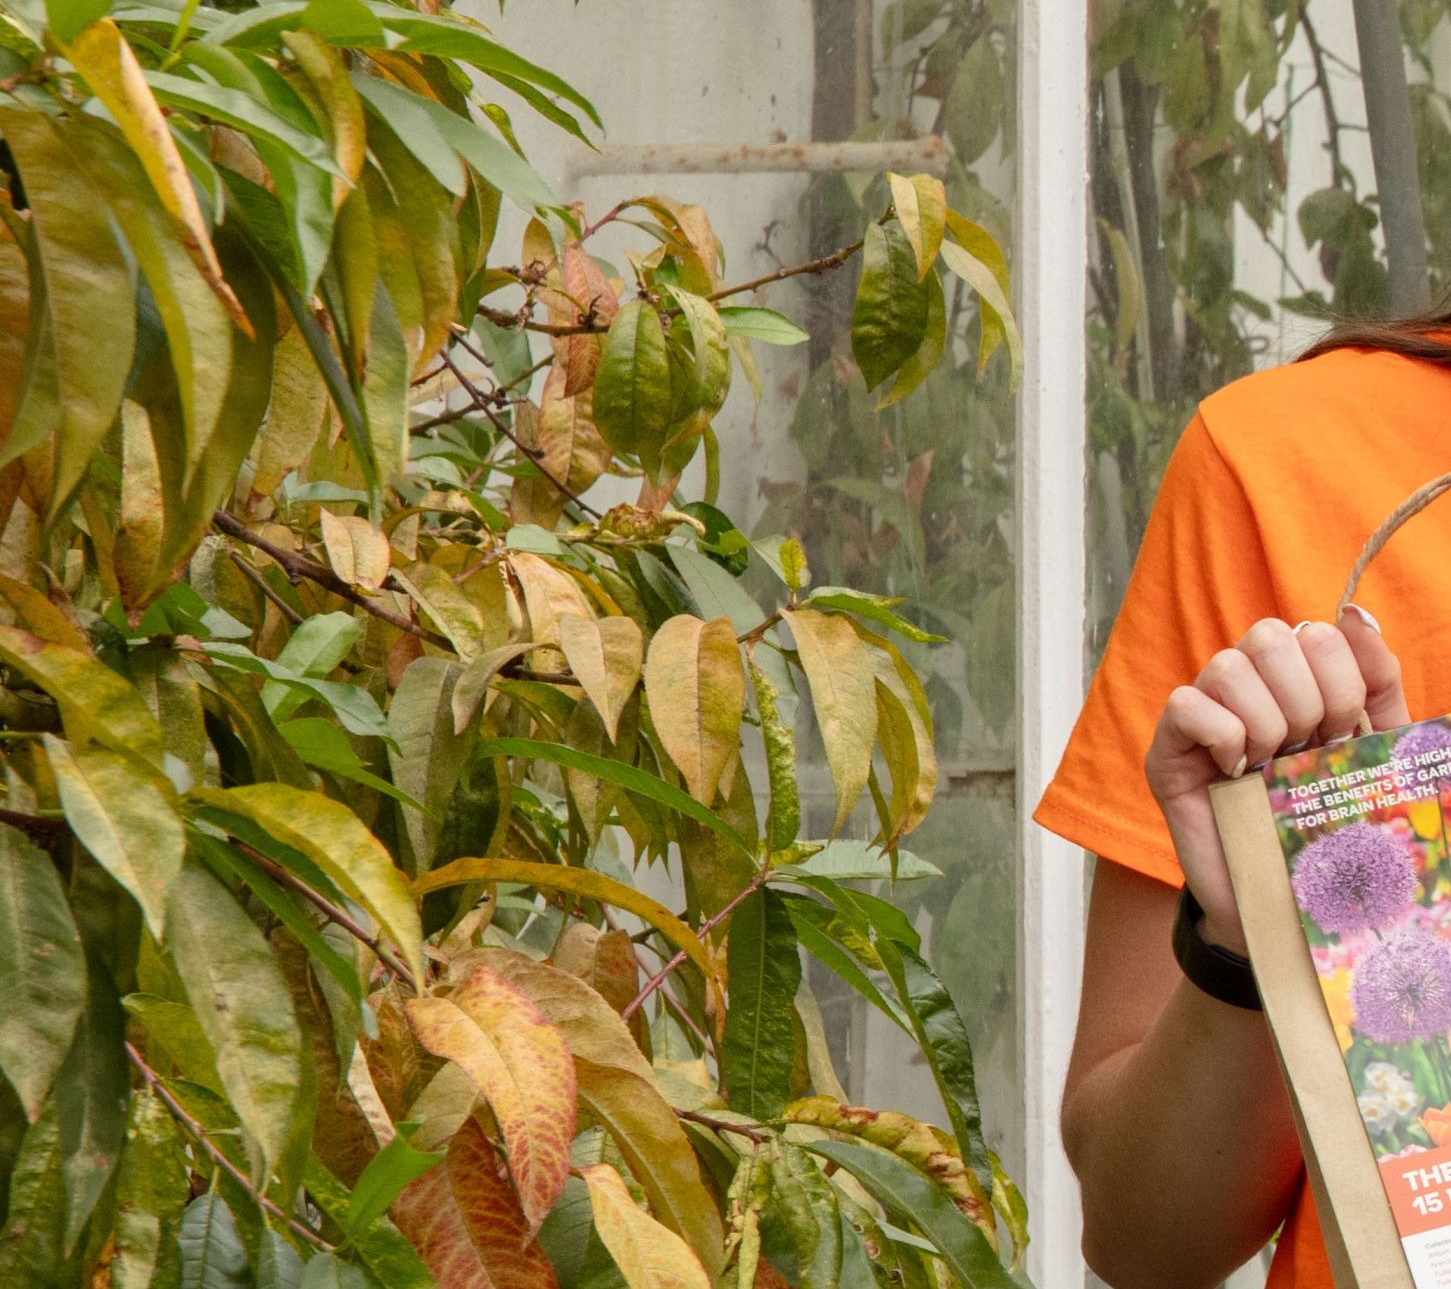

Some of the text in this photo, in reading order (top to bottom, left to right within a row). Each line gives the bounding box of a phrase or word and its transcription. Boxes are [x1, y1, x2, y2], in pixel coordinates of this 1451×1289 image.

[1287, 769, 1366, 800] TOGETHER
[1366, 757, 1413, 779] WE'RE
[1291, 797, 1322, 815] THE
[1322, 778, 1393, 807] BENEFITS
[1393, 773, 1414, 788] OF
[1295, 782, 1438, 830] FOR BRAIN HEALTH.
[1410, 1190, 1445, 1218] 15
